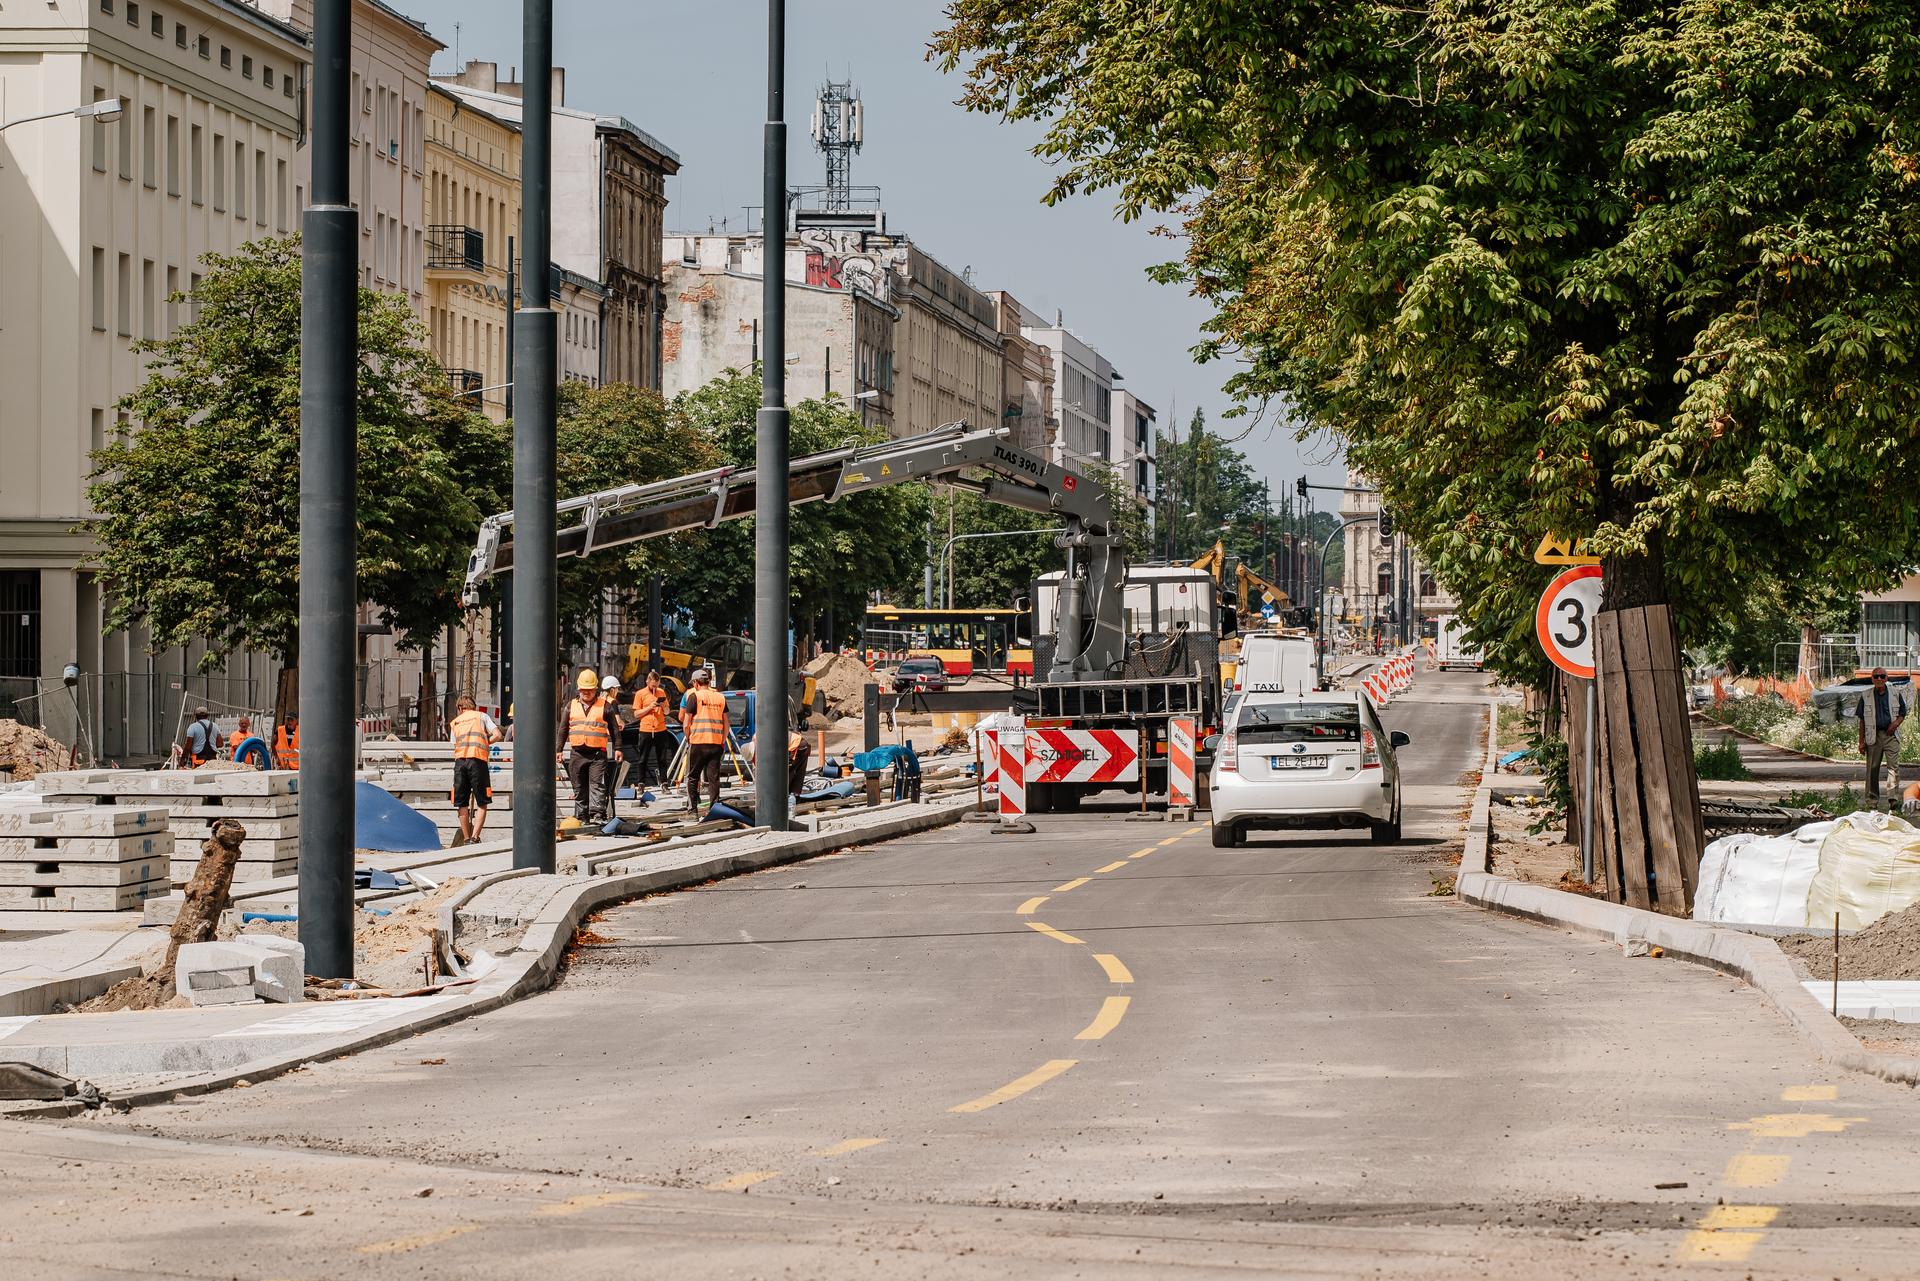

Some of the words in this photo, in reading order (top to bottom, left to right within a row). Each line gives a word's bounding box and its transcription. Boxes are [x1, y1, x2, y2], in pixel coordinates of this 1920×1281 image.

[1040, 749, 1099, 761] SZMIGIEL
[1278, 757, 1291, 767] EL
[1294, 756, 1325, 767] 2EJ12
